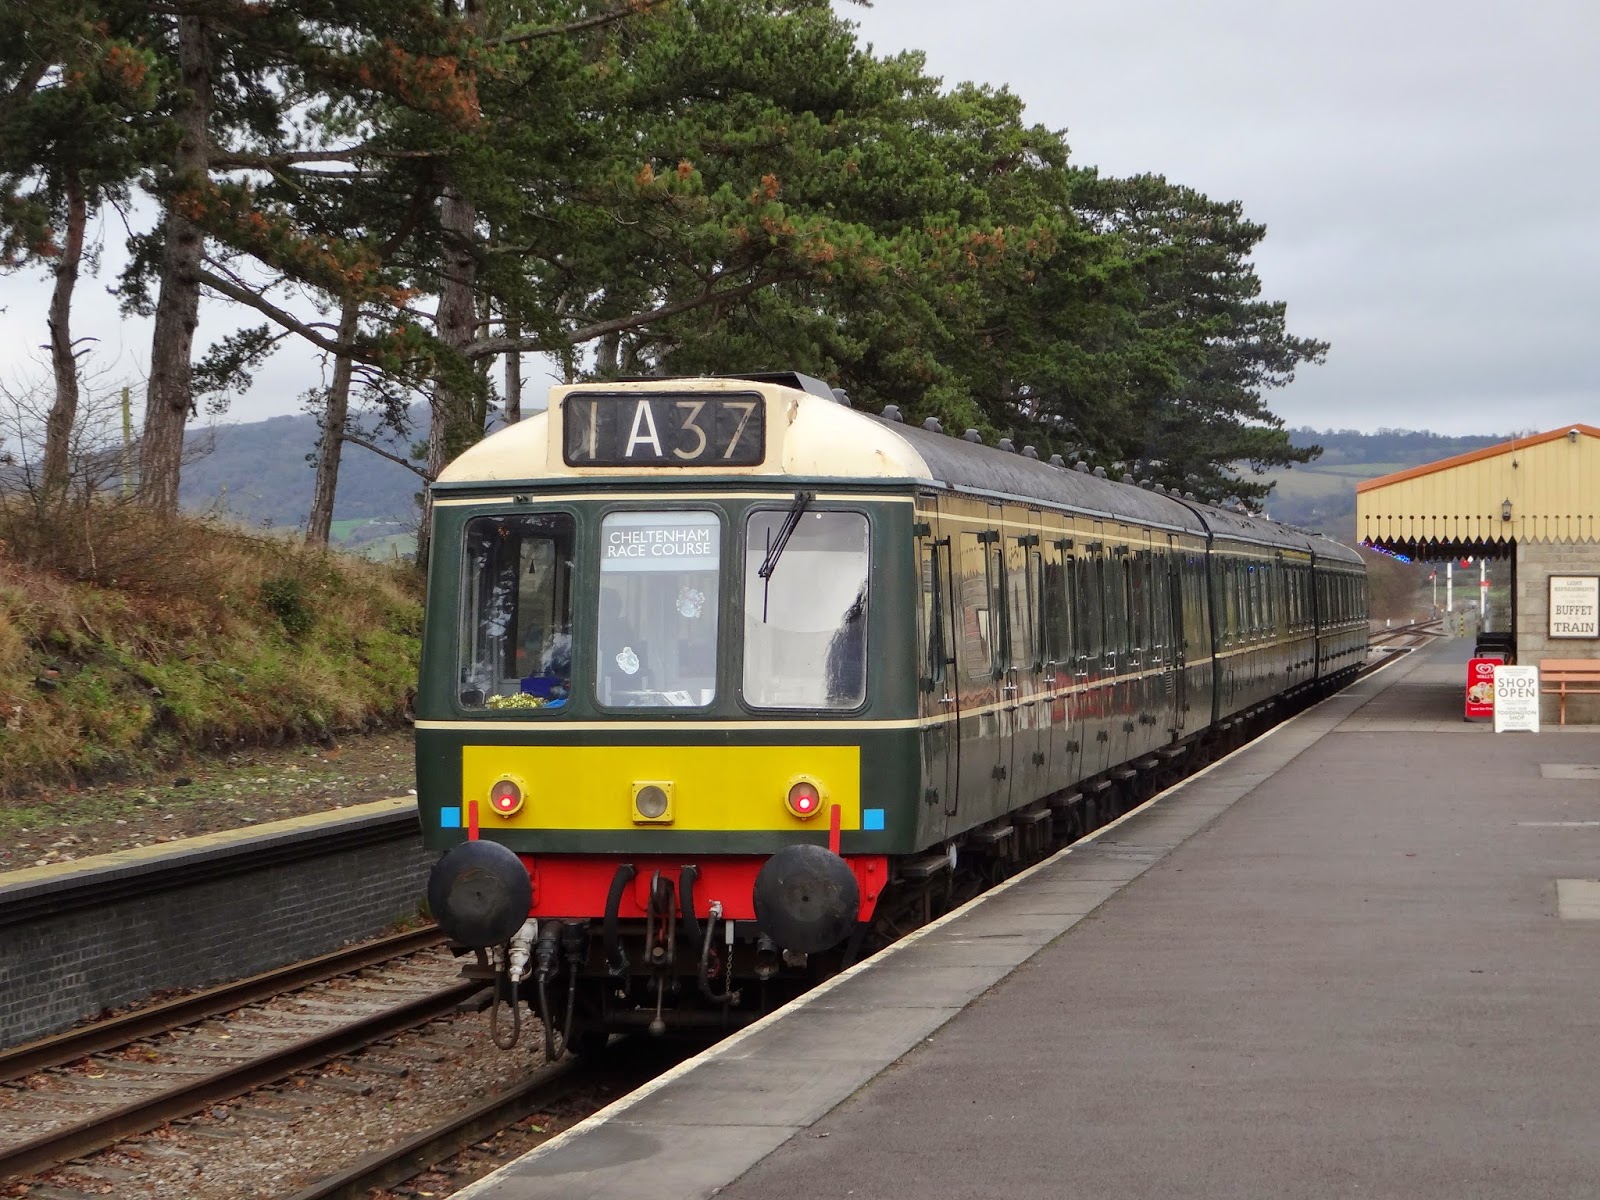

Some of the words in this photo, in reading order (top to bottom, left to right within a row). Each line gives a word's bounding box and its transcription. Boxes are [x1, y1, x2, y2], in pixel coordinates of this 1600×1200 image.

[609, 529, 709, 544] CHELTENHAM
[608, 544, 646, 557] RACE
[651, 542, 711, 556] COURSE
[1555, 605, 1593, 616] BUFFET
[1553, 622, 1595, 633] TRAIN
[1498, 677, 1535, 688] SHOP
[1498, 688, 1535, 698] OPEN
